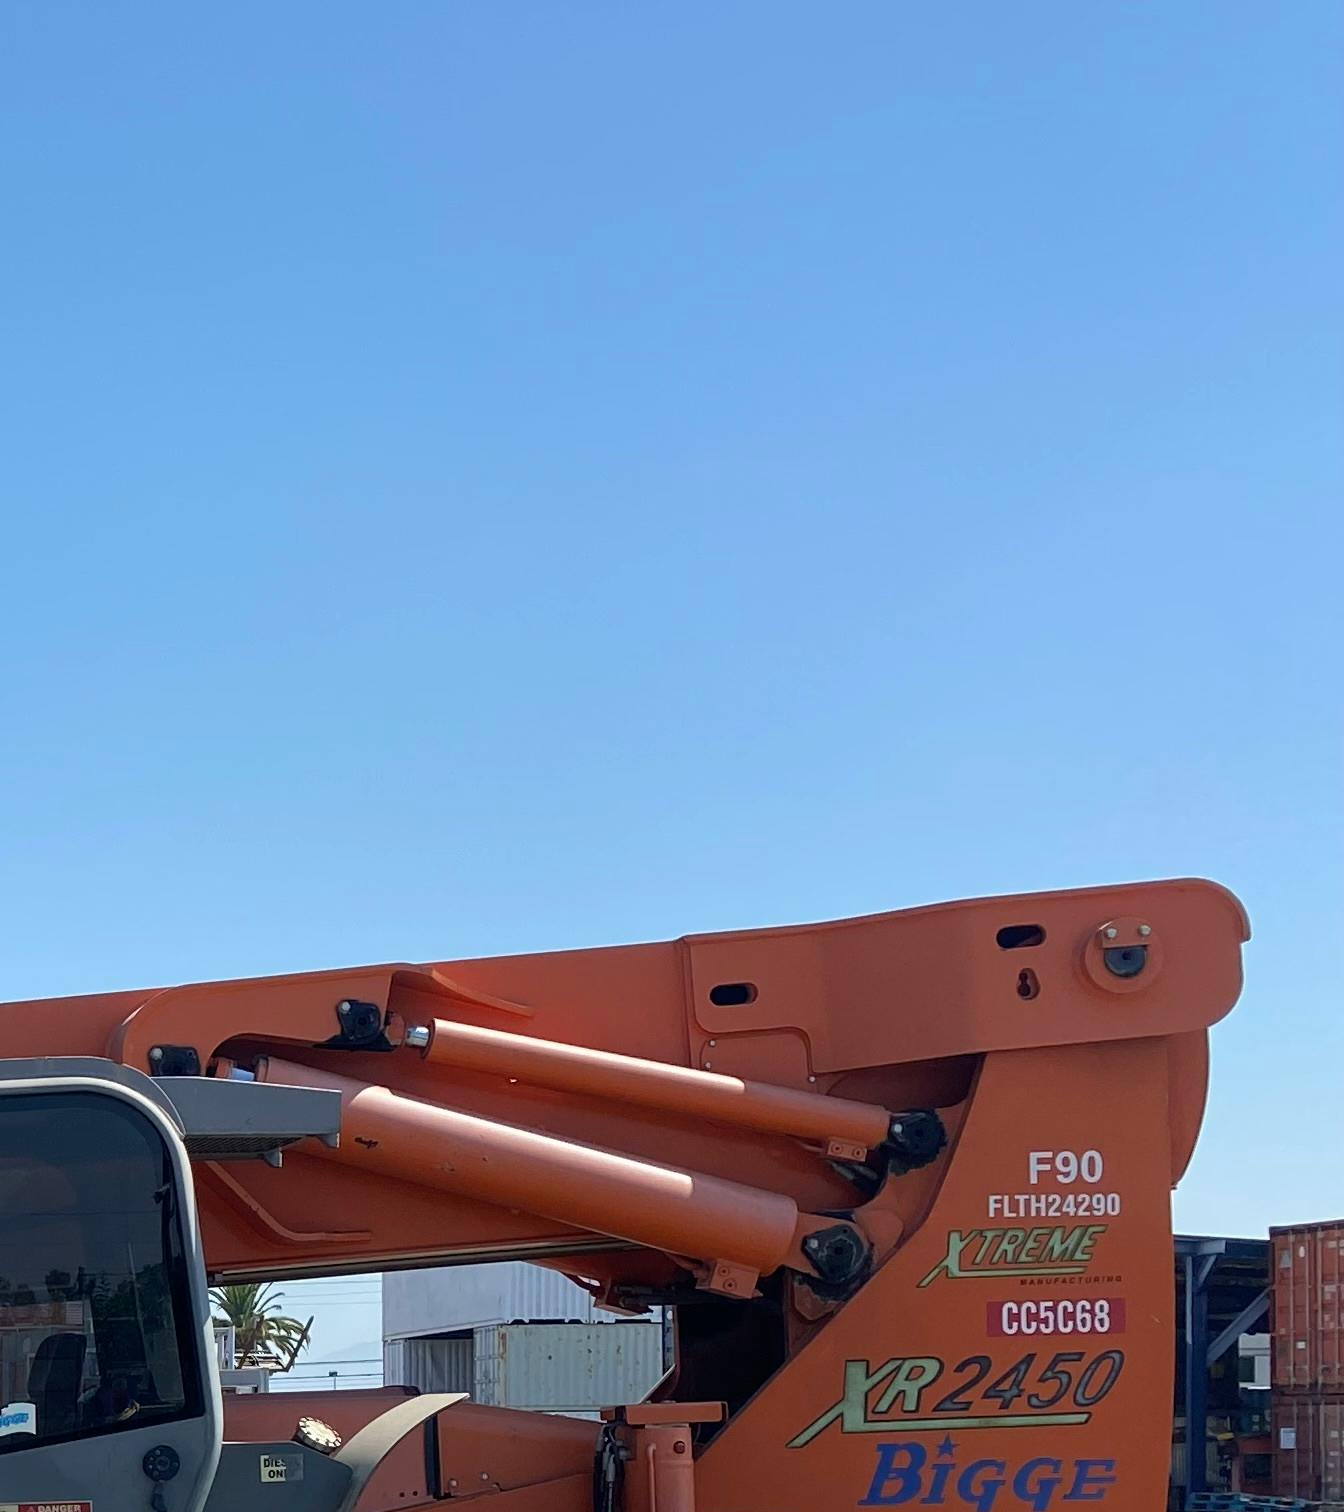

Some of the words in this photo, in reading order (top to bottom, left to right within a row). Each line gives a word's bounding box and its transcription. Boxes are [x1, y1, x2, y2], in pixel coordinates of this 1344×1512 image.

[1029, 1150, 1103, 1184] F90
[988, 1193, 1121, 1217] FLTH24290
[916, 1224, 1108, 1288] XTREME
[1020, 1275, 1122, 1286] MANUFACTURING
[1002, 1299, 1111, 1336] CC5C68
[37, 1504, 81, 1512] DANGER
